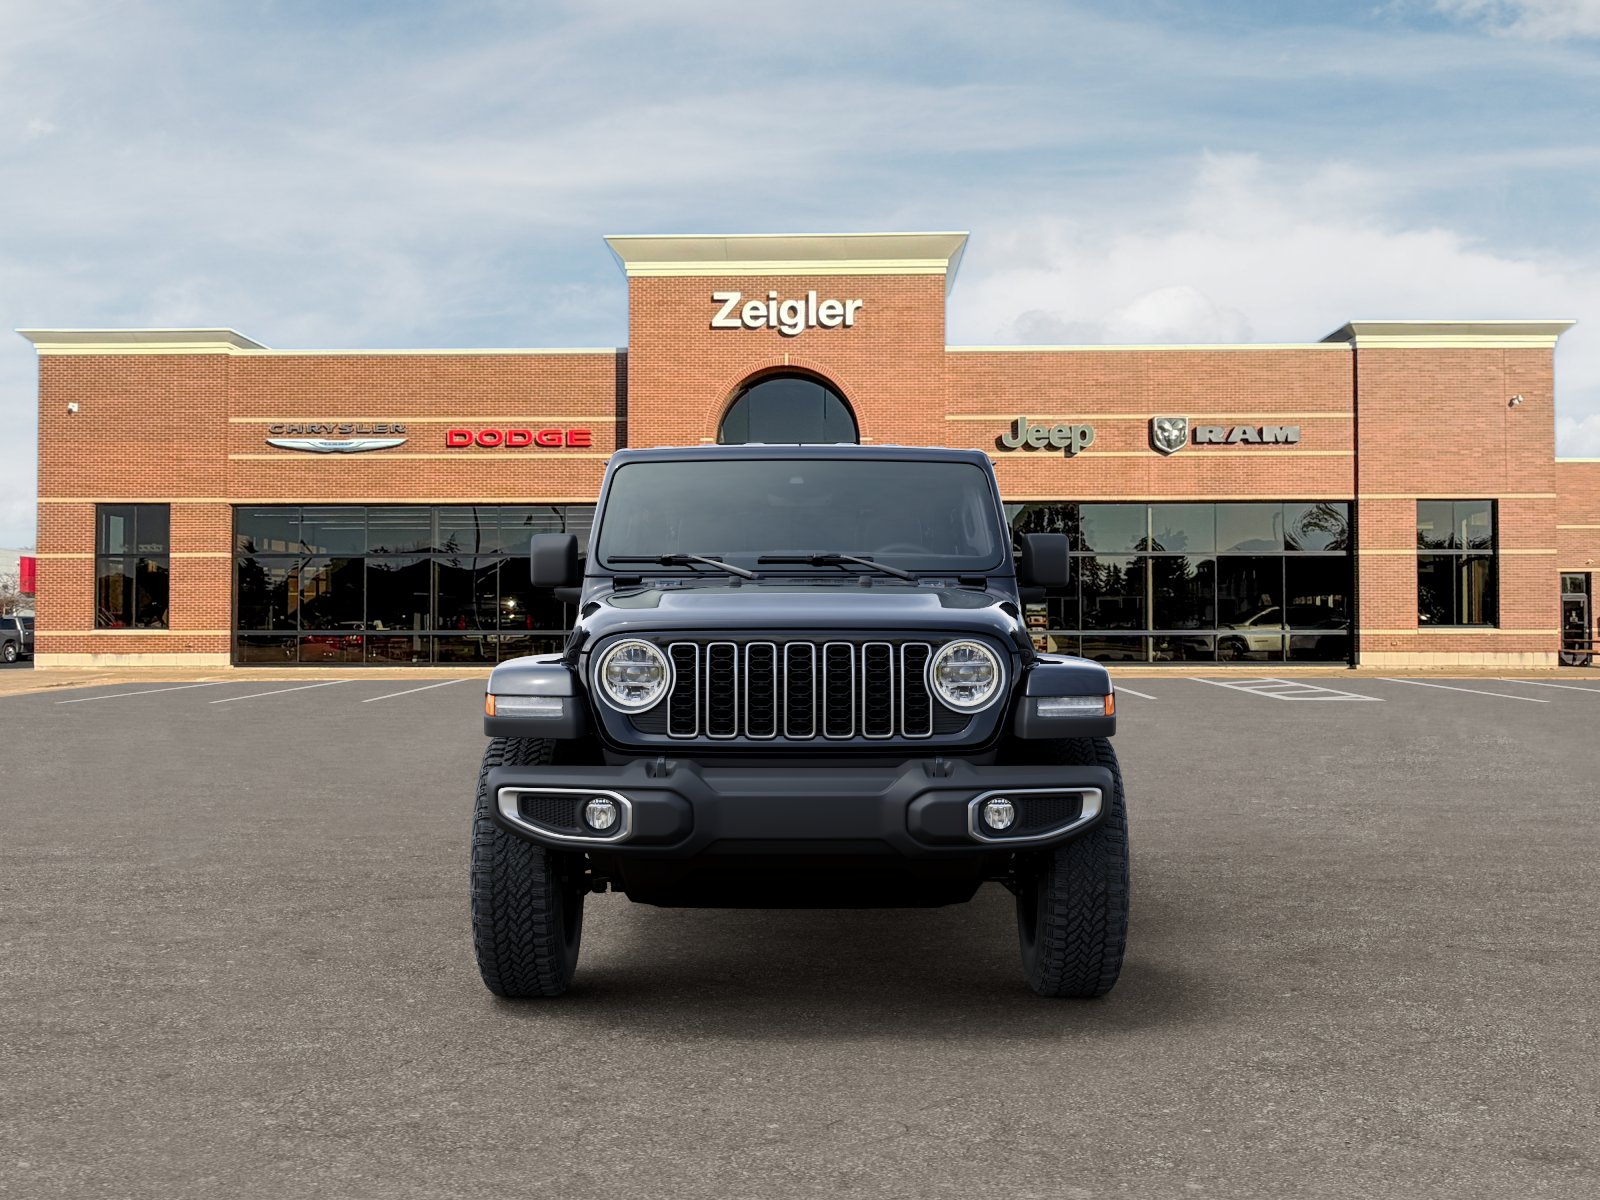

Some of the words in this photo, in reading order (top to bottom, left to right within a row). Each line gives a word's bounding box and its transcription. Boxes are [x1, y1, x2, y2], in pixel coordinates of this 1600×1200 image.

[711, 290, 863, 335] Zeigler
[269, 423, 406, 434] CHRYSLER
[447, 428, 592, 447] DODGE
[1001, 416, 1095, 454] Jeep
[1195, 425, 1300, 443] RAM
